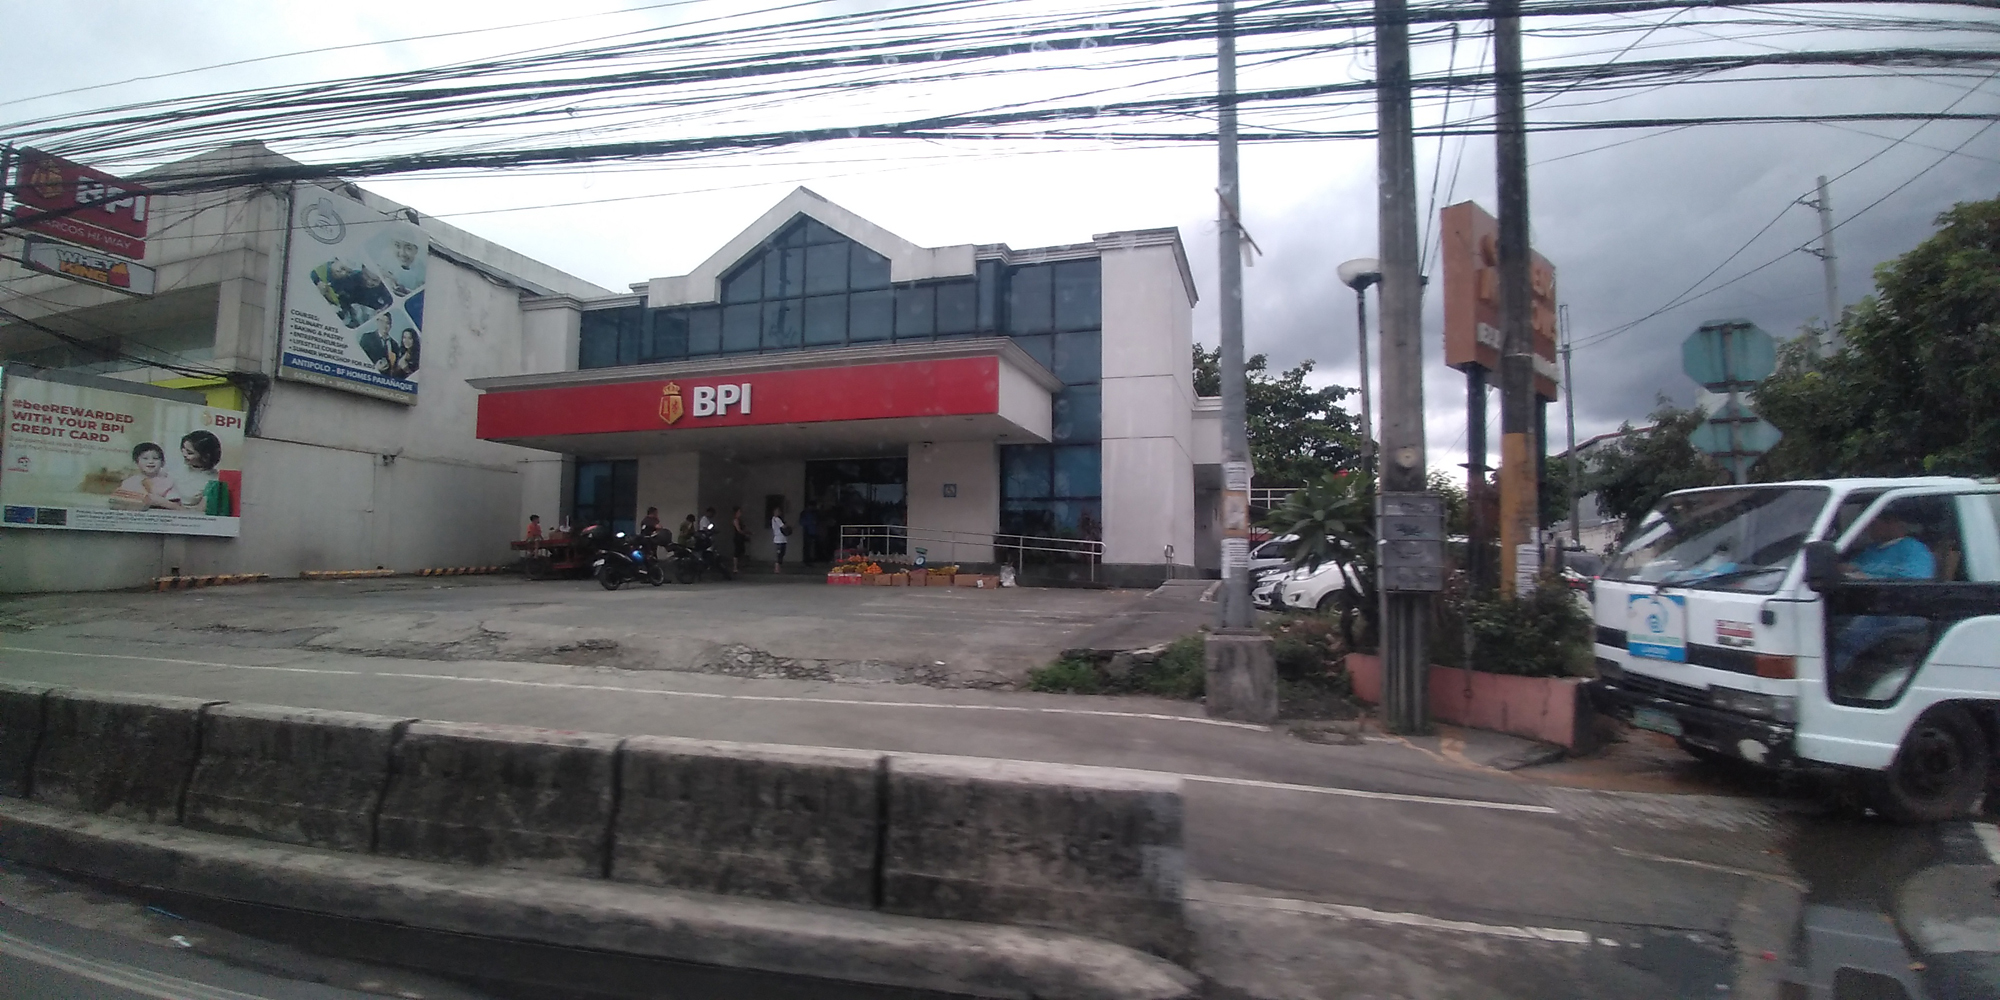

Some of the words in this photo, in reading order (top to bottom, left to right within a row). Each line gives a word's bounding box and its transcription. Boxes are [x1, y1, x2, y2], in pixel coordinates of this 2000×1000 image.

[75, 175, 146, 222] BPI
[39, 219, 85, 238] ARCOS
[56, 249, 114, 270] WHEY
[59, 261, 109, 283] KING
[290, 309, 320, 321] COURSES:
[294, 317, 323, 329] CULINARY
[324, 325, 339, 333] ARTS
[294, 324, 317, 335] BAKING
[324, 332, 344, 341] PASTRY
[293, 338, 320, 350] LIFESTYLE
[321, 345, 344, 355] COURSE
[292, 345, 318, 356] SUMMER
[318, 352, 351, 364] WORKSHOP
[363, 362, 376, 370] KIDS
[291, 357, 331, 373] ANTIPOLO
[336, 367, 346, 376] BF
[346, 370, 372, 381] HOMES
[372, 376, 414, 391] PARAÑAQUE
[693, 382, 752, 417] BPI
[12, 398, 134, 424] #beeREWARDED
[11, 410, 52, 424] WITH
[57, 416, 98, 430] YOUR
[101, 422, 125, 434] BPI
[11, 422, 65, 437] CREDIT
[69, 430, 110, 443] CARD
[214, 414, 241, 430] BPI
